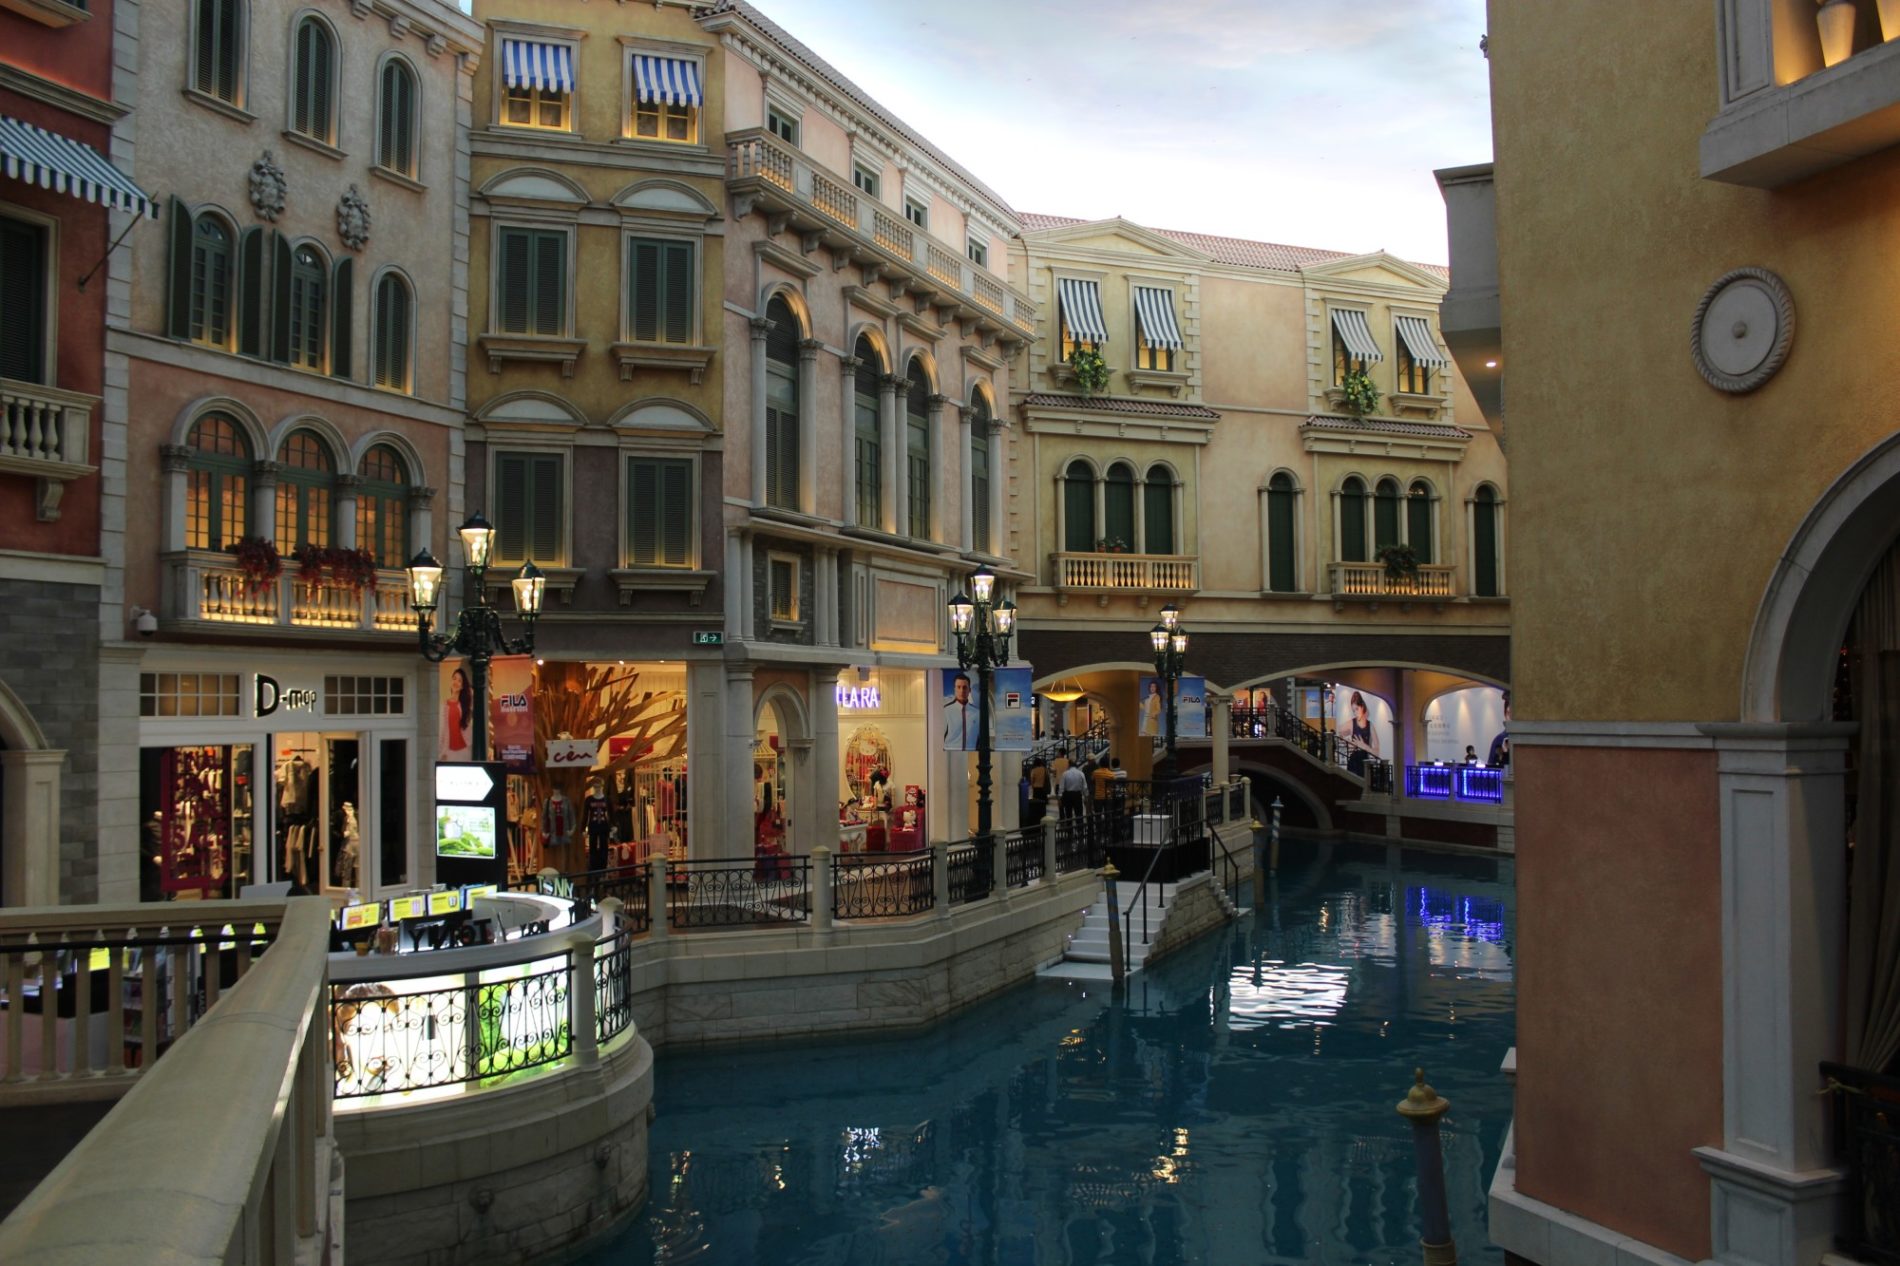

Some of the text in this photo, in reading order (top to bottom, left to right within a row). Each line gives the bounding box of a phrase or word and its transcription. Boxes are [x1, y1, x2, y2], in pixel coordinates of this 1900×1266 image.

[254, 672, 317, 718] D-mop
[501, 694, 527, 707] FILA
[1183, 696, 1201, 704] FILA
